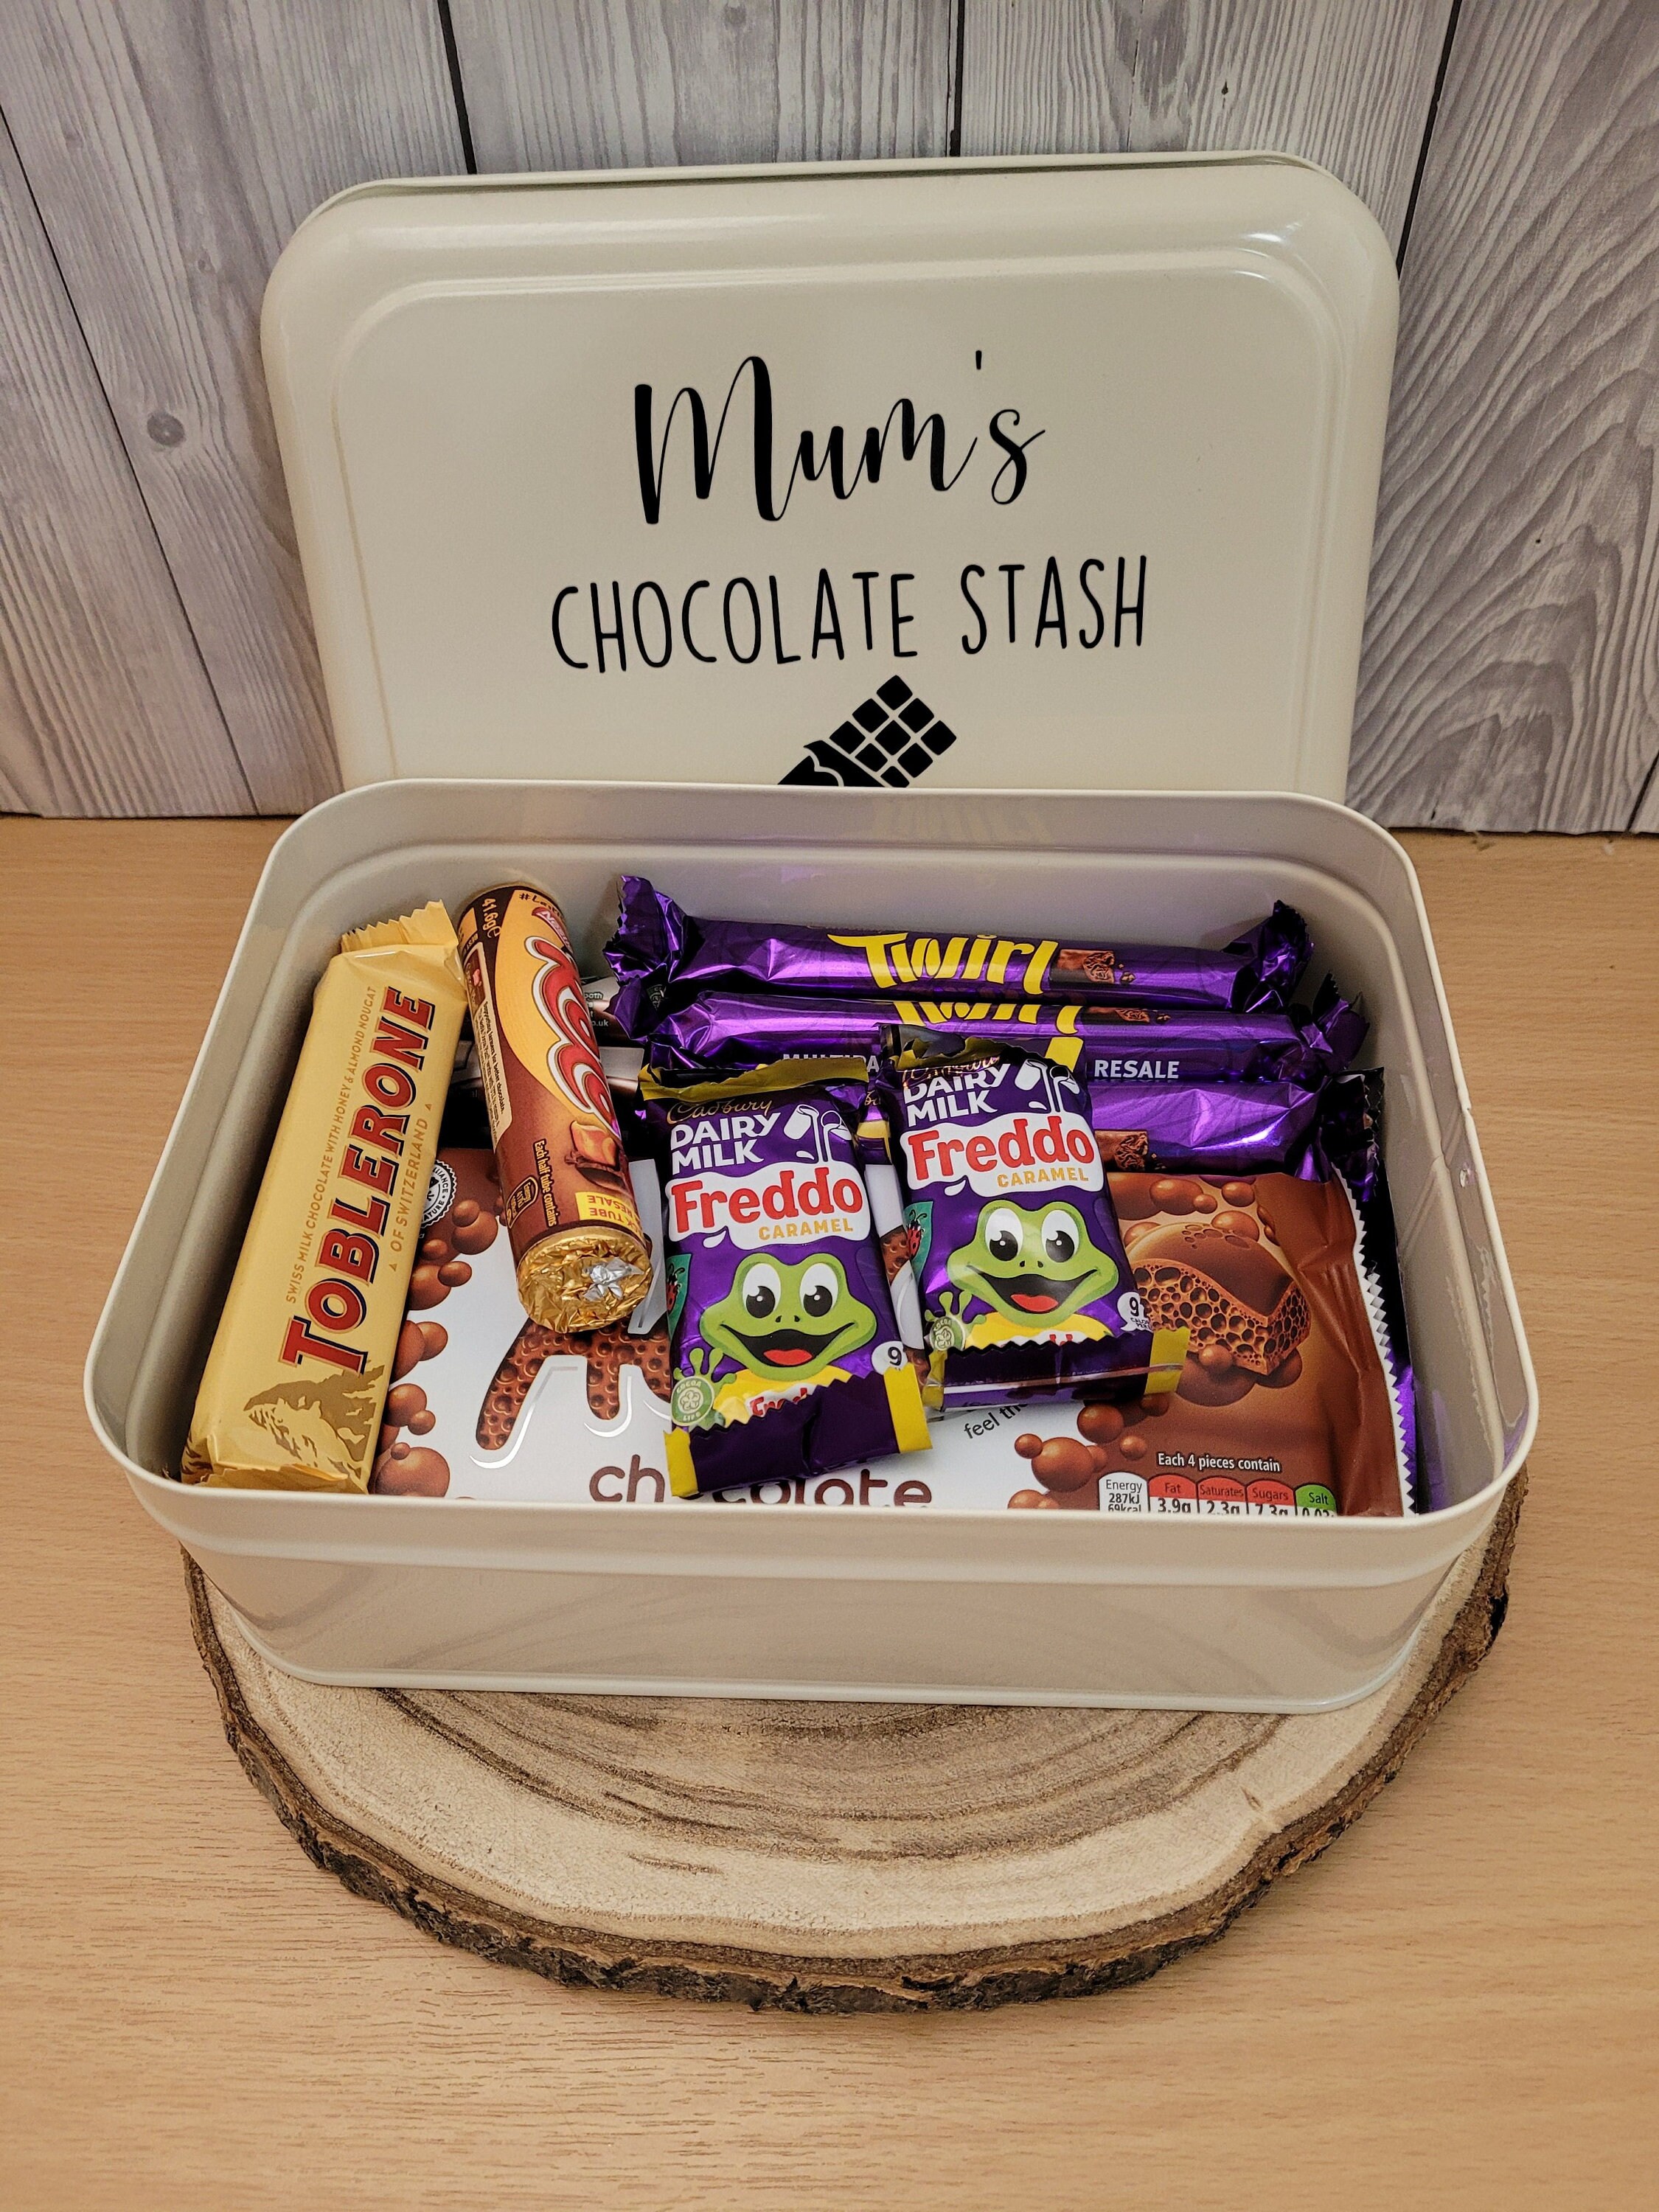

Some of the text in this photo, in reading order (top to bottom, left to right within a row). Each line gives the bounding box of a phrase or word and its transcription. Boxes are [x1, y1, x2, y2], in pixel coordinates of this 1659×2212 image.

[635, 349, 1046, 525] Mum's
[551, 555, 1147, 674] CHOCOLATE STASH
[827, 932, 1058, 995] Twirl
[1093, 1060, 1180, 1079] RESALE
[903, 1063, 1011, 1105] DAIRY
[667, 1099, 773, 1124] Cadbury
[907, 1090, 998, 1127] MILK
[670, 1112, 782, 1151] DAIRY
[286, 987, 377, 1304] SWISS MILK CHOCOLATE WITH HONEY & ALMOND NOUGAT
[672, 1139, 764, 1175] MILK
[907, 1116, 1095, 1181] Freddo
[277, 986, 436, 1375] TOBLERONE
[390, 1118, 428, 1252] OF SWITZERLAND
[535, 1140, 558, 1227] Each half tube contains
[997, 1166, 1089, 1189] CARAMEL
[422, 1200, 444, 1221] ATURE
[671, 1167, 863, 1234] Freddo
[590, 1207, 625, 1223] TUBE
[758, 1217, 854, 1241] CARAMEL
[964, 1412, 1000, 1439] feel
[1158, 1453, 1280, 1472] Each 4 pieces contain
[1105, 1479, 1142, 1494] Energy
[1108, 1492, 1140, 1504] 287kJ
[1165, 1482, 1181, 1494] Fat
[1200, 1484, 1245, 1498] Saturates
[1253, 1488, 1289, 1501] Sugars
[1309, 1492, 1329, 1505] Salt
[1158, 1498, 1192, 1513] 3.9g
